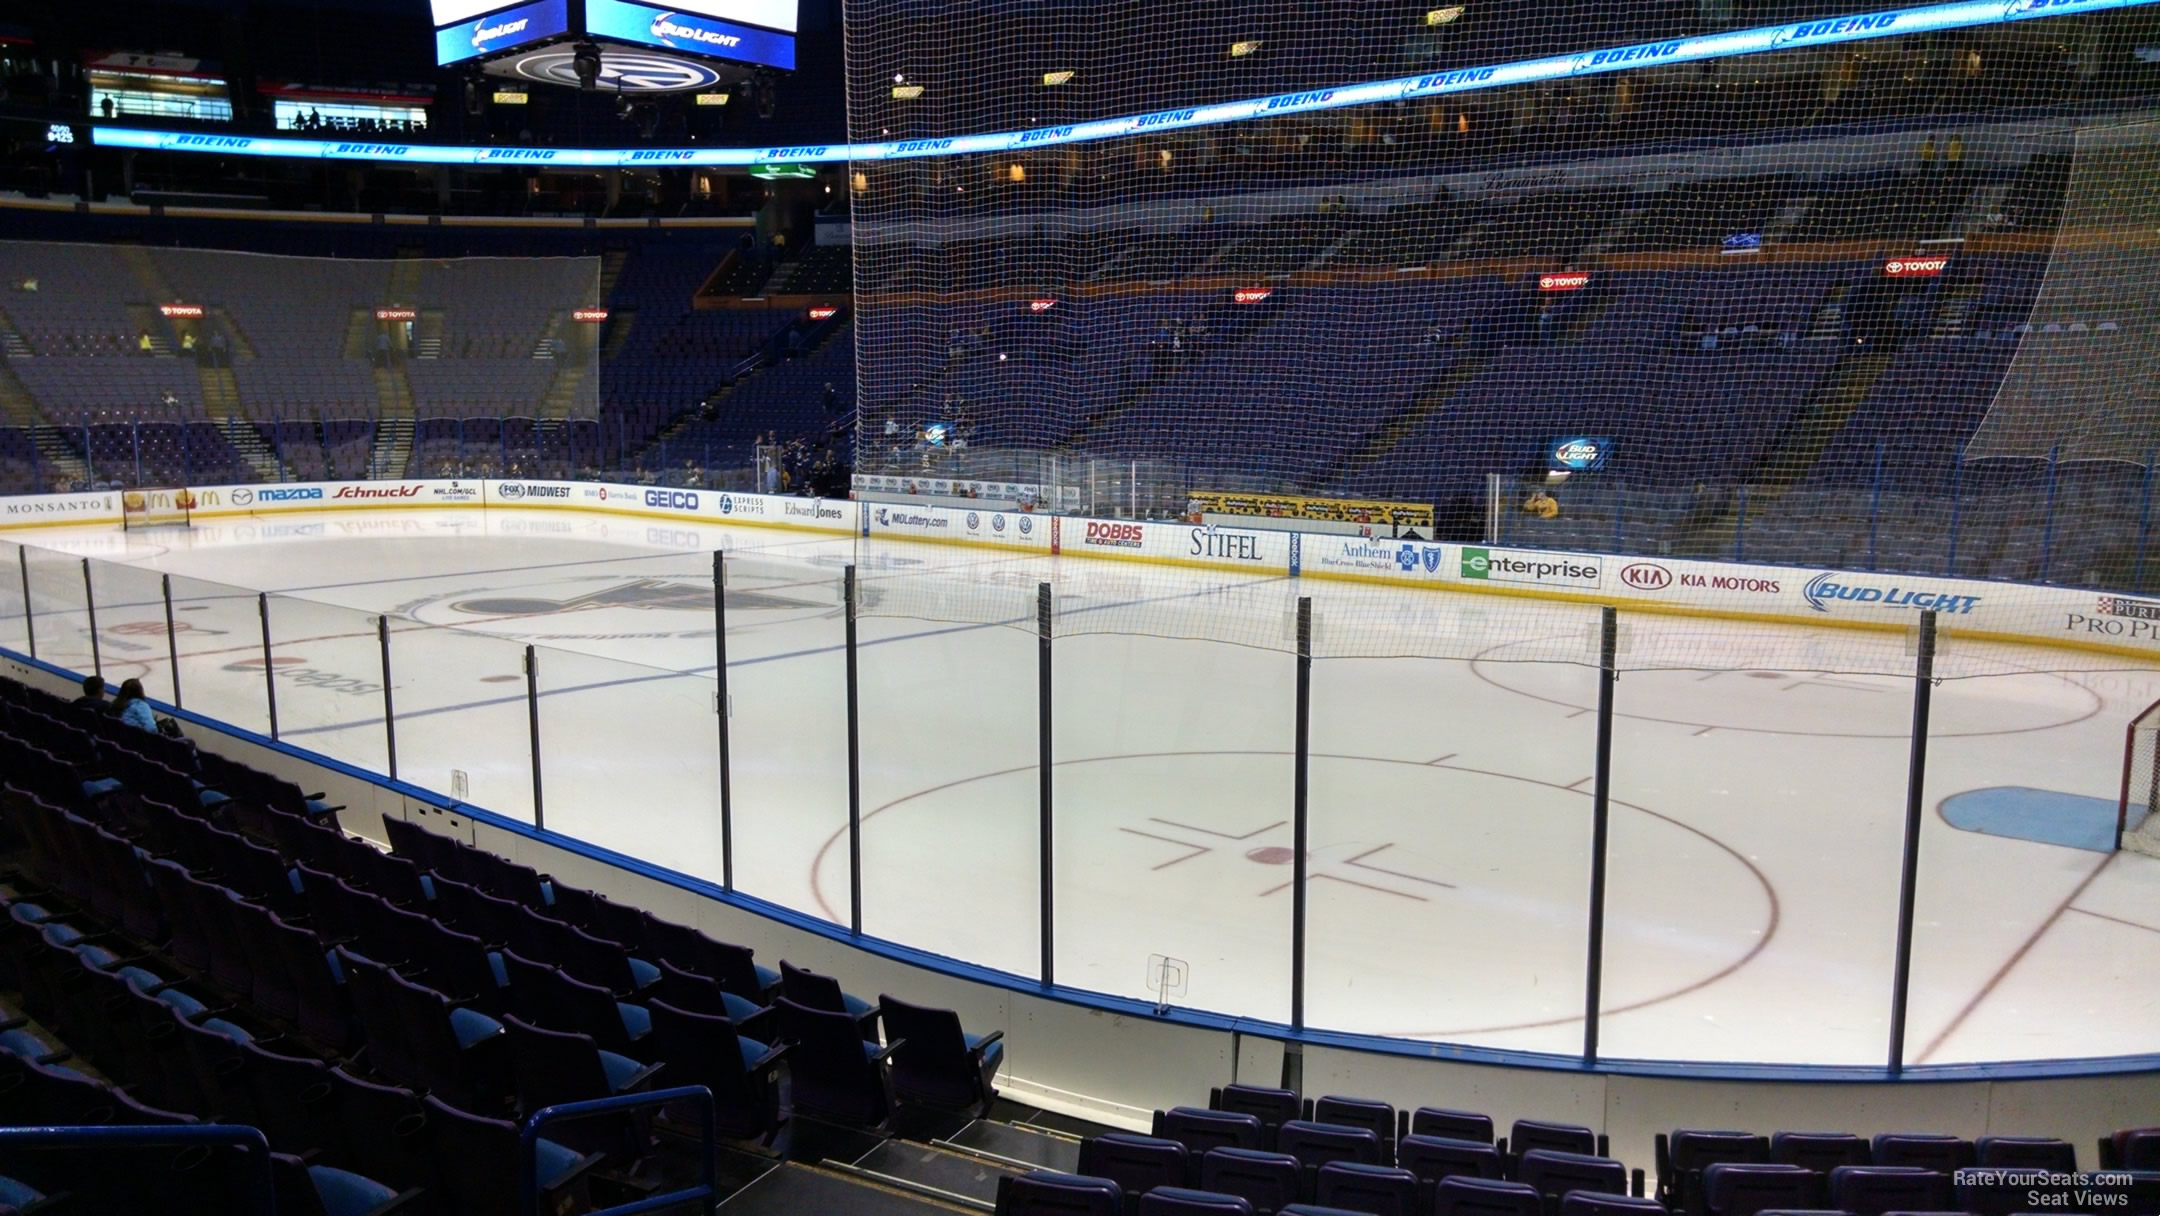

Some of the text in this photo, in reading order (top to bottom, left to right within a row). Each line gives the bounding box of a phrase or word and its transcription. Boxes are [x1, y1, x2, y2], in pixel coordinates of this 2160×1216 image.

[660, 20, 741, 47] BUD LIGHT
[1793, 14, 1898, 39] BOEING
[1591, 43, 1680, 66] BOEING
[1417, 68, 1496, 89] BOEING
[1267, 91, 1334, 109] BOEING
[1137, 111, 1194, 127] BOEING
[177, 134, 253, 148] BOEING
[1020, 127, 1072, 143] BOEING
[337, 143, 409, 157] BOEING
[768, 147, 829, 158] BOEING
[898, 139, 952, 152] BOEING
[489, 149, 557, 160] BOEING
[632, 151, 696, 160] BOEING
[171, 307, 202, 315] TOYOTA
[1568, 444, 1596, 453] BUD
[332, 485, 424, 499] Schnucks
[504, 485, 571, 498] FOX MIDWEST
[7, 501, 101, 514] MONSANTO
[645, 490, 699, 510] GEICO
[734, 496, 764, 506] EXPRESS
[734, 504, 764, 514] SCRIPTS
[785, 502, 843, 519] Edward Jones
[892, 513, 948, 528] MOLottery.com
[1087, 522, 1143, 540] DOBBS
[1190, 528, 1263, 560] STIFEL
[1291, 532, 1299, 567] Reebok
[1341, 542, 1391, 559] Anthem
[1468, 555, 1598, 579] enterprise
[1629, 569, 1663, 586] KIA
[1681, 574, 1780, 593] KIA MOTORS
[1814, 582, 1982, 614] BUD LIGHT
[2115, 605, 2160, 619] PURI
[2065, 613, 2124, 635] PRO
